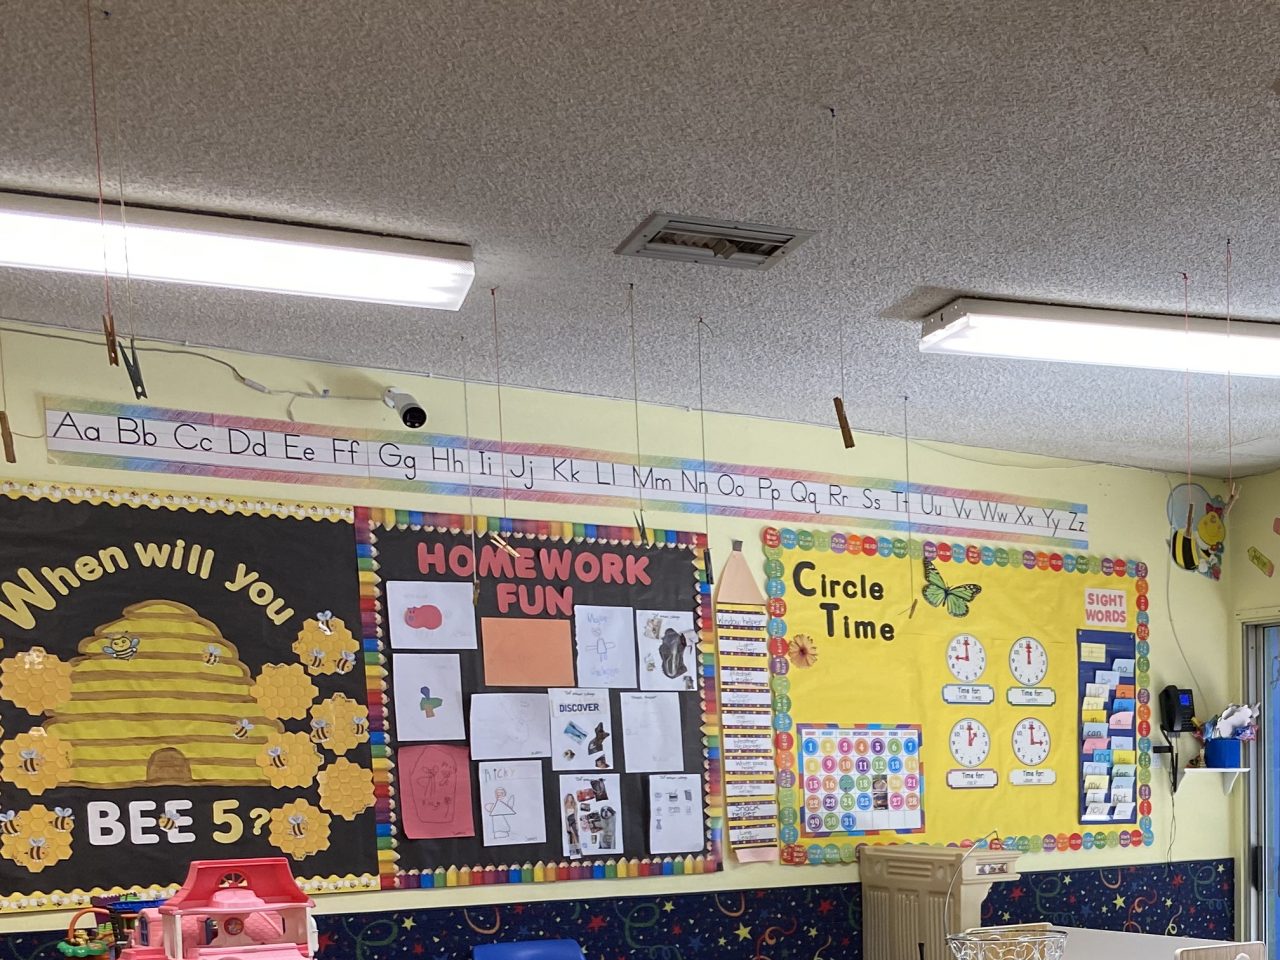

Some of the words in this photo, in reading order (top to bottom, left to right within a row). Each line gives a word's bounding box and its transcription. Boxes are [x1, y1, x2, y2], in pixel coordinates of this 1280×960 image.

[53, 412, 100, 442] Aa
[118, 419, 158, 446] Bb
[173, 421, 214, 451] Cc
[227, 426, 269, 457] Dd
[285, 432, 314, 461] Ee
[333, 438, 359, 464] Ff
[379, 443, 416, 480] Gg
[432, 447, 465, 472] Hh
[511, 453, 536, 489] Jj
[553, 458, 579, 481] Kk
[597, 463, 615, 485] Ll
[633, 466, 670, 489] Mm
[682, 470, 708, 492] Nn
[718, 472, 744, 496] Oo
[759, 478, 780, 510] Pp
[791, 481, 820, 513] Qq
[830, 485, 848, 507] Rr
[863, 489, 880, 509] Ss
[892, 491, 909, 513] Tt
[921, 494, 942, 516] Uu
[953, 498, 971, 519] Vv
[979, 502, 1007, 523] Ww
[1015, 505, 1034, 526] Xx
[1042, 508, 1060, 536] Yy
[1069, 511, 1087, 533] Zz
[417, 542, 652, 586] HOMEWORK
[0, 546, 129, 630] When
[134, 539, 215, 580] will
[224, 563, 295, 626] you
[792, 561, 884, 601] Circle
[496, 582, 574, 616] FUN
[1087, 593, 1124, 607] SIGHT
[819, 602, 895, 641] Time
[1085, 609, 1126, 623] WORDS
[559, 703, 600, 713] DISCOVER
[809, 743, 813, 751] 1
[843, 743, 848, 751] 3
[859, 743, 864, 751] 4
[876, 743, 880, 751] 5
[892, 743, 897, 751] 6
[908, 743, 913, 751] 7
[827, 760, 831, 768] 9
[859, 762, 867, 770] 11
[826, 780, 834, 788] 16
[826, 798, 835, 806] 23
[87, 800, 196, 846] BEE
[810, 818, 819, 827] 29
[844, 817, 853, 825] 31
